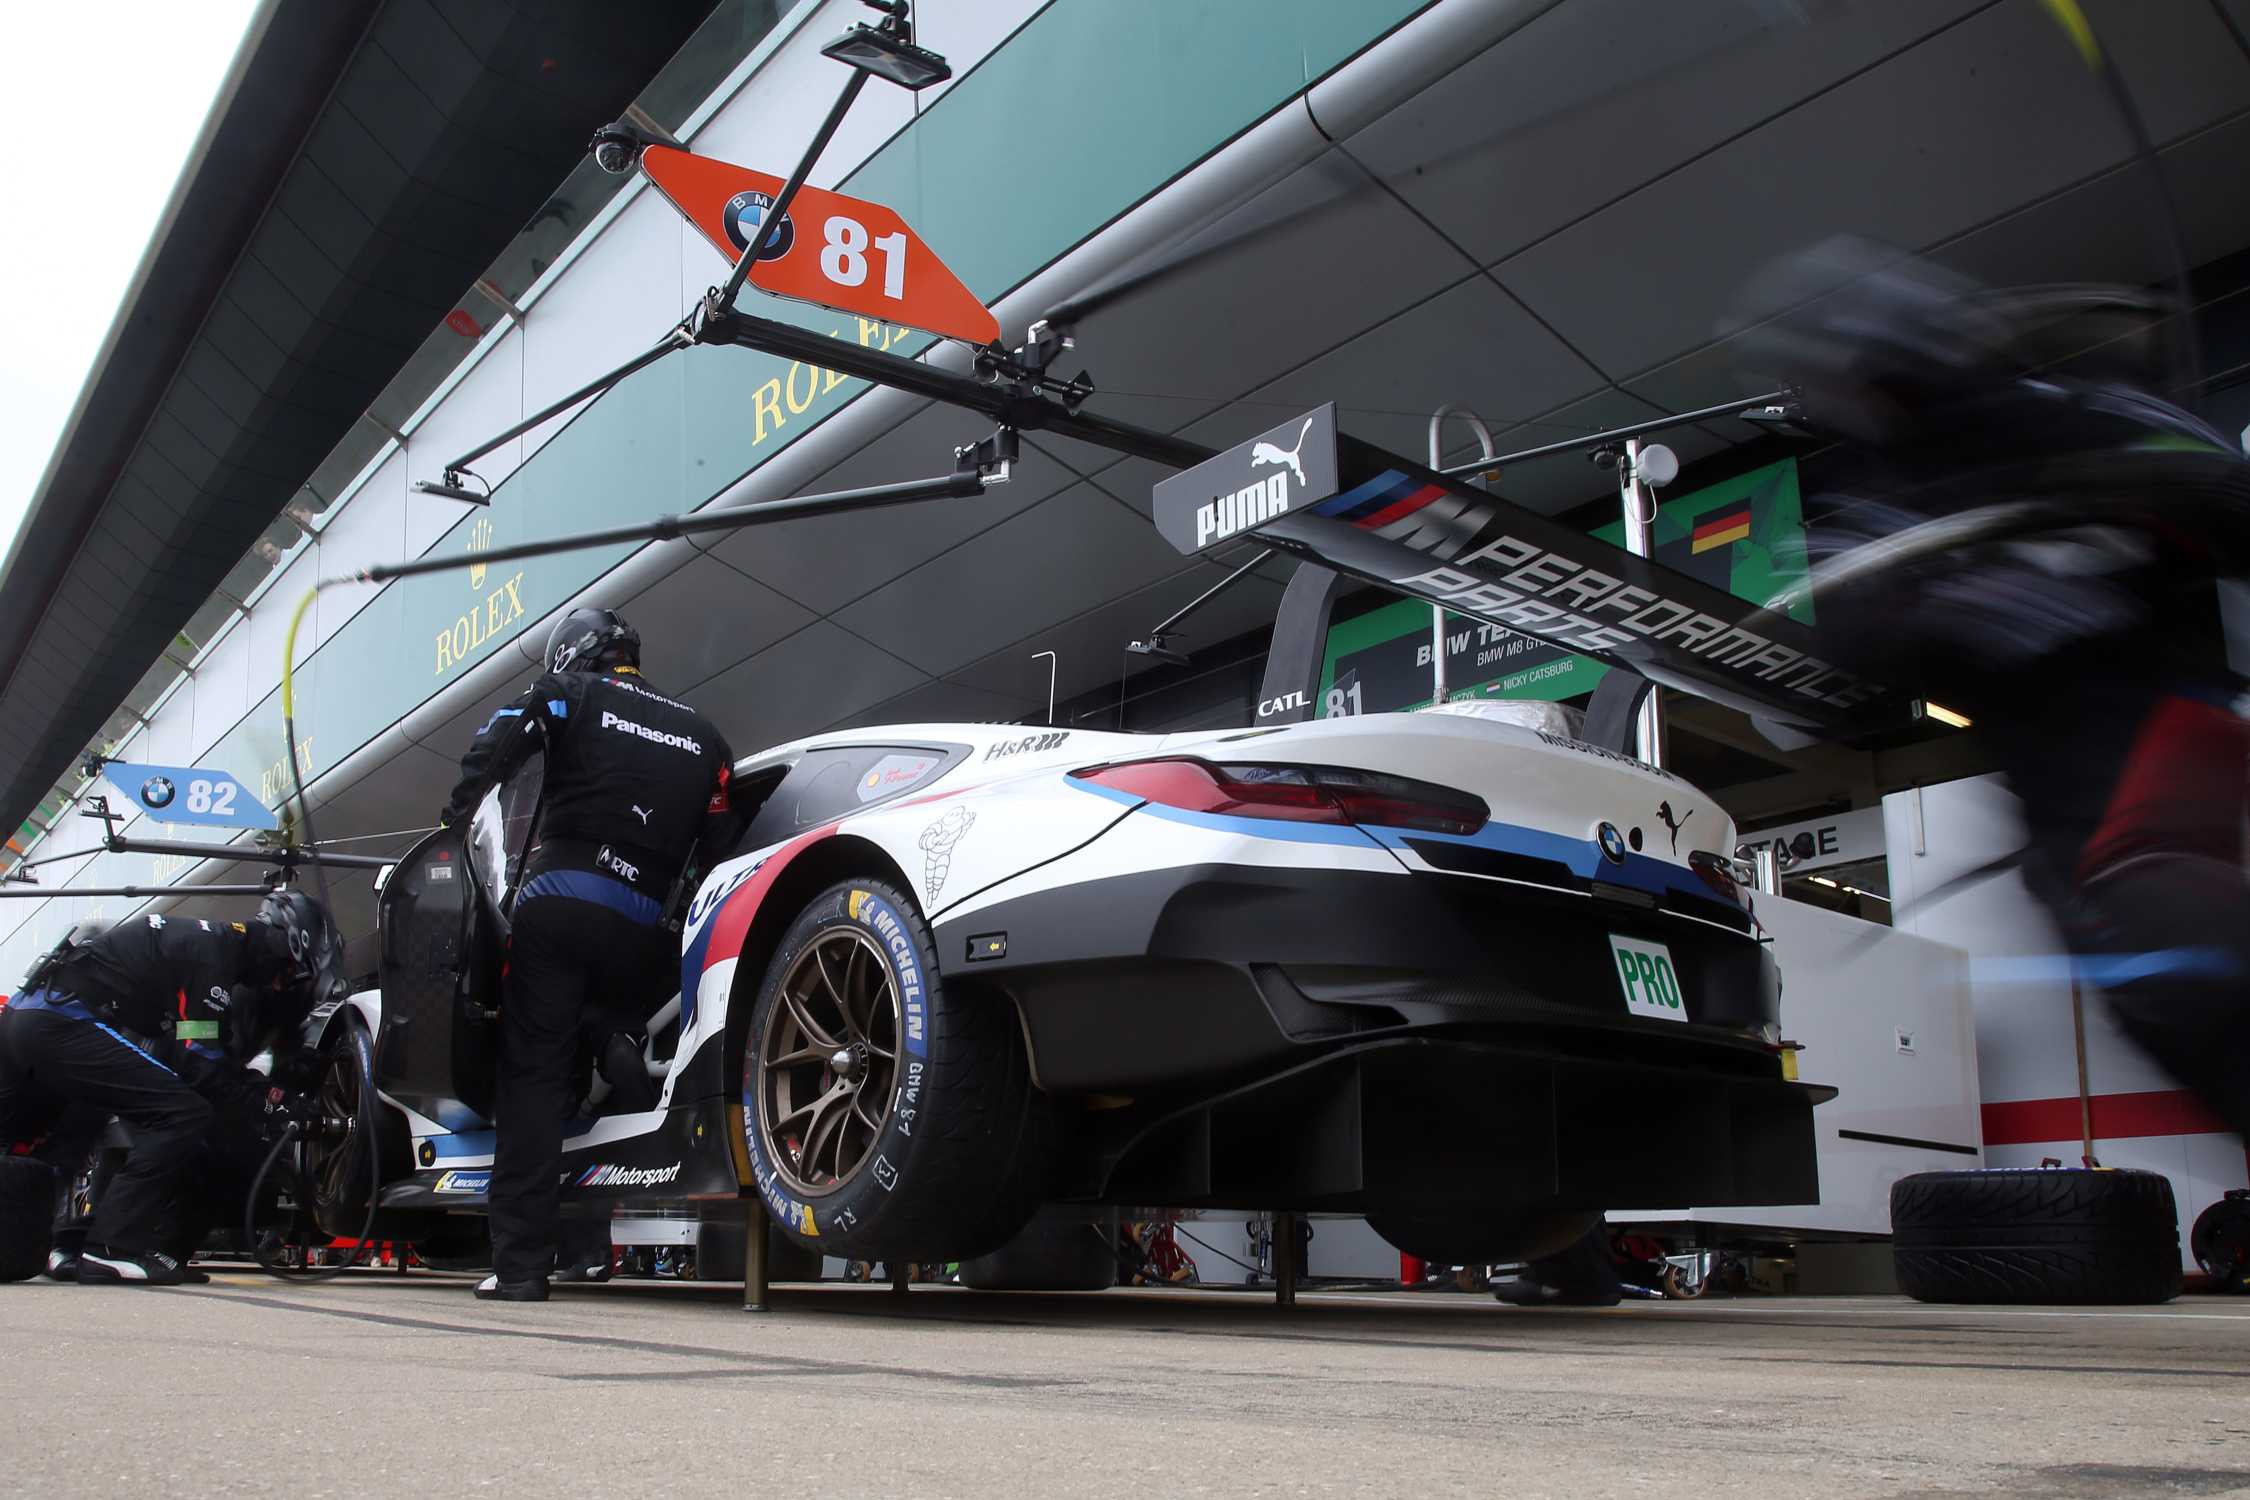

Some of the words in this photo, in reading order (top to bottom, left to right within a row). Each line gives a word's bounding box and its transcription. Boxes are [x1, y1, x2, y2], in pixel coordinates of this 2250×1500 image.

[820, 216, 907, 300] 81
[1197, 471, 1288, 548] PUMA
[434, 571, 526, 676] ROLEX
[1391, 566, 1638, 651] PARTS
[1454, 535, 1887, 709] PERFORMANCE
[1477, 645, 1505, 667] BMW
[1506, 640, 1523, 657] M8
[1503, 673, 1527, 691] NICKY
[1529, 660, 1574, 683] CATSBURG
[635, 686, 696, 714] Motorsport
[1258, 690, 1311, 717] CATL
[1325, 680, 1363, 719] 81
[601, 711, 702, 756] Panasonic
[187, 779, 238, 816] 82
[873, 910, 925, 1041] MICHELIN
[1616, 949, 1680, 1009] PRO
[906, 1062, 924, 1104] BMW
[603, 1161, 681, 1188] Motorsport
